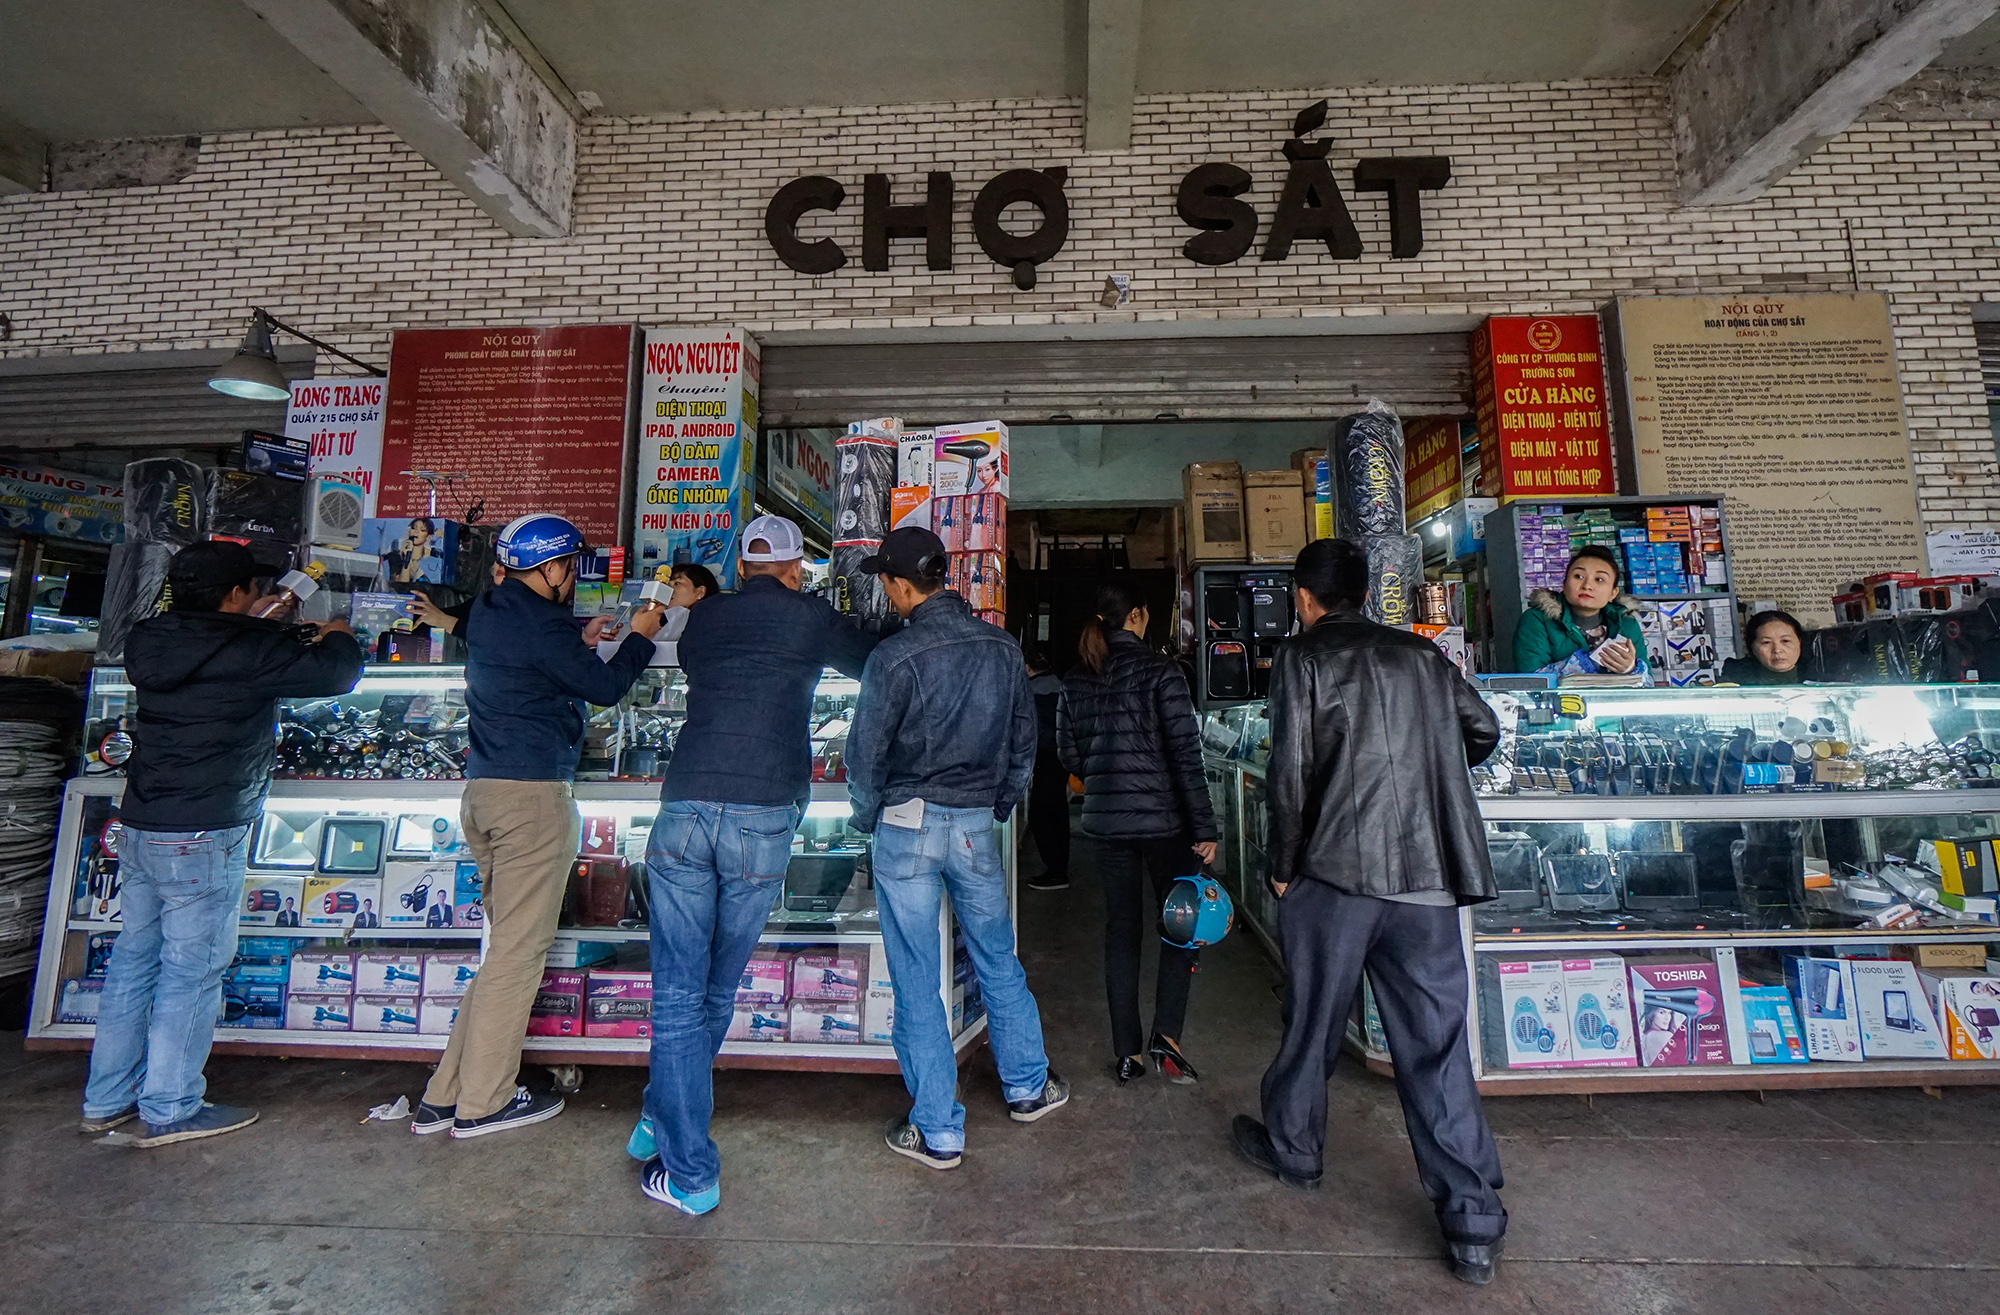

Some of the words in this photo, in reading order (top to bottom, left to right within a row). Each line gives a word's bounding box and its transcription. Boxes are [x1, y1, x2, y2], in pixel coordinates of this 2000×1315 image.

[764, 165, 1069, 291] CHỢ
[1176, 100, 1451, 266] SẮT
[1722, 302, 1749, 316] NỘI
[1753, 304, 1784, 314] QUY
[1704, 319, 1725, 329] HOẠT
[1728, 318, 1750, 329] ĐỘNG
[1752, 316, 1769, 326] CỦA
[1771, 318, 1788, 328] CHỢ
[1790, 316, 1806, 326] SẮT
[482, 334, 507, 347] NỘI
[512, 335, 541, 345] QUY
[445, 350, 469, 359] PHÒNG
[470, 350, 489, 359] CHÁY
[490, 349, 509, 358] CHỮA
[511, 349, 530, 358] CHÁY
[531, 348, 545, 357] CỦA
[547, 349, 562, 358] CHỢ
[563, 346, 576, 356] SẮT
[647, 342, 684, 383] NGỌC
[686, 332, 740, 382] NGUYỆT
[1496, 353, 1518, 364] CÔNG
[1521, 354, 1529, 363] TY
[1532, 354, 1542, 363] CP
[1544, 353, 1576, 362] THƯƠNG
[1578, 353, 1597, 362] BINH
[1521, 366, 1554, 379] TRƯỜNG
[1557, 367, 1575, 378] SƠN
[293, 387, 330, 407] LONG
[334, 385, 381, 407] TRANG
[658, 385, 726, 394] Chuyên:
[1504, 382, 1542, 405] CỬA
[1546, 383, 1596, 404] HÀNG
[292, 411, 317, 424] QUẦY
[339, 413, 358, 424] CHỢ
[360, 407, 379, 421] SẮT
[656, 399, 686, 420] ĐIỆN
[689, 401, 726, 419] THOẠI
[1502, 410, 1525, 432] ĐIỆN
[1527, 413, 1555, 432] THOẠI
[1564, 409, 1587, 431] ĐIỆN
[1589, 405, 1601, 427] TỬ
[646, 424, 678, 438] IPAD,
[682, 423, 735, 437] ANDROID
[900, 434, 933, 443] CHAOBA
[310, 428, 335, 461] VẬT
[339, 430, 357, 456] TƯ
[660, 442, 681, 462] BỘ
[684, 441, 719, 460] ĐÀM
[1418, 428, 1447, 464] HÀNG
[1510, 438, 1533, 461] ĐIỆN
[1536, 438, 1557, 457] MÁY
[1565, 437, 1584, 460] VẬT
[1586, 439, 1599, 456] TƯ
[797, 433, 830, 492] NGỌC
[0, 466, 87, 492] RUNG
[657, 467, 720, 481] CAMERA
[1368, 446, 1388, 502] CROWN
[1514, 470, 1533, 486] KIM
[1535, 466, 1552, 486] KHÍ
[1554, 464, 1579, 486] TỔNG
[1582, 468, 1601, 489] HỢP
[647, 484, 678, 504] ỐNG
[682, 484, 728, 504] NHÒM
[177, 483, 191, 528] CROWN
[642, 514, 667, 533] PHỤ
[671, 510, 700, 532] KIỆN
[704, 510, 712, 529] Ô
[716, 510, 731, 529] TÔ
[836, 576, 849, 614] CRO
[1381, 572, 1403, 625] CROW
[1654, 970, 1707, 982] TOSHIBA
